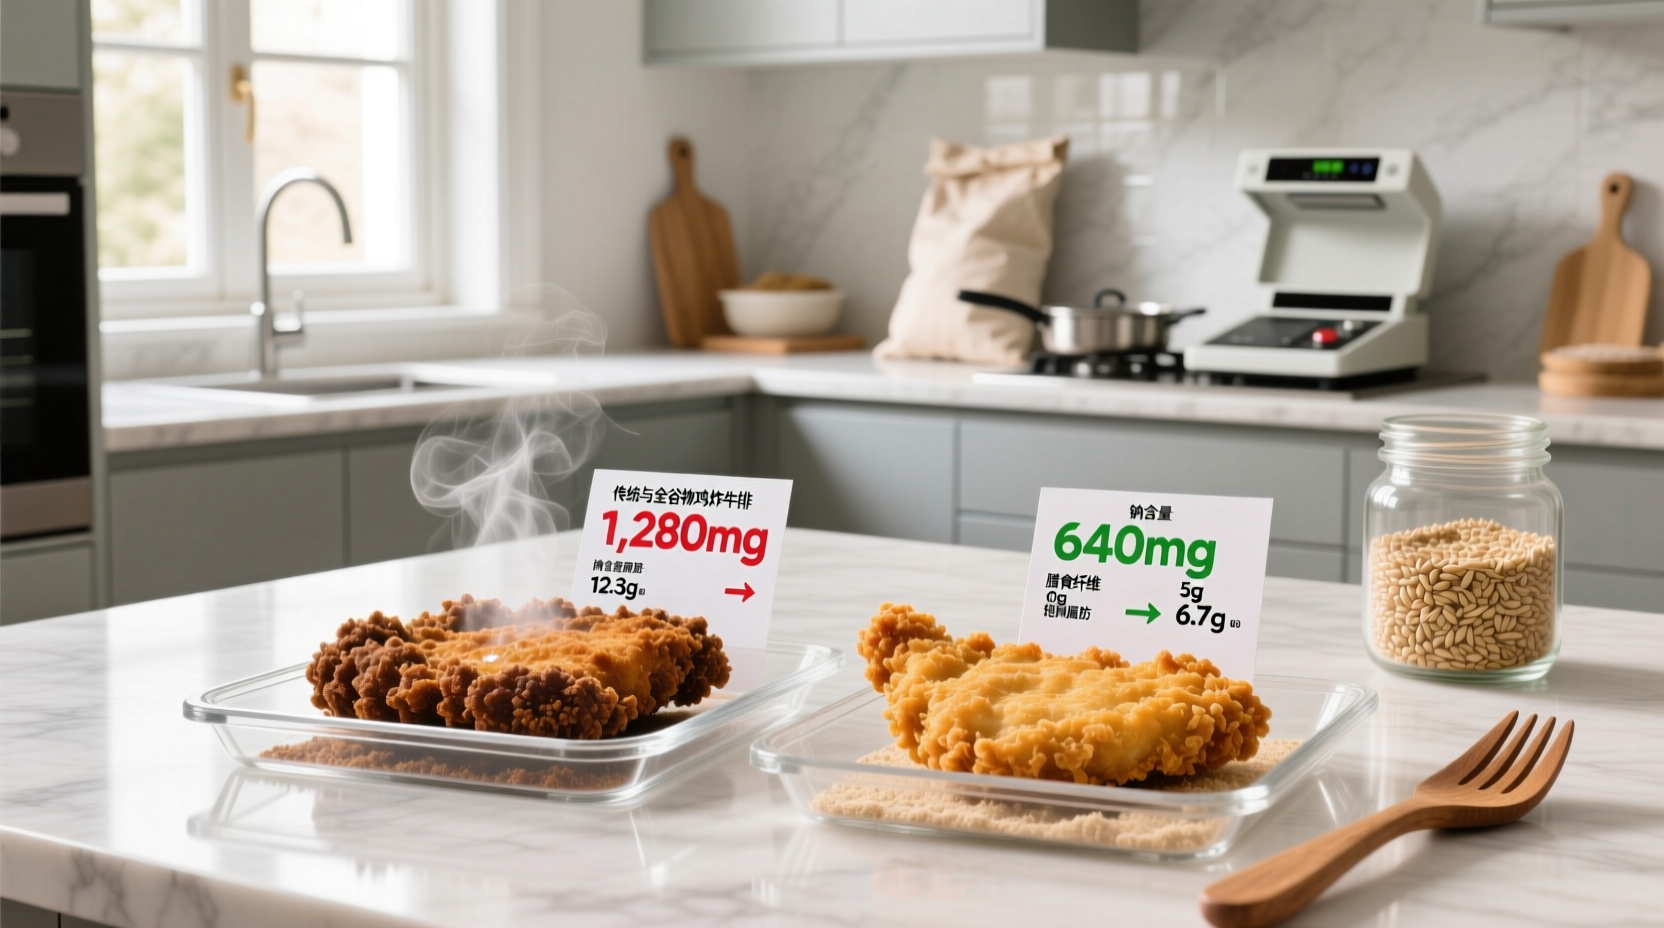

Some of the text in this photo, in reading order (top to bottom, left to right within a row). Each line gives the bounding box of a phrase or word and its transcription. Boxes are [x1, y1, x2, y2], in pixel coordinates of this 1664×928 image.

[602, 510, 768, 567] 1,280mg
[1054, 522, 1216, 579] 640mg
[591, 576, 638, 600] 12.3g
[1180, 582, 1204, 603] 5g
[1176, 604, 1226, 633] 6.7g
